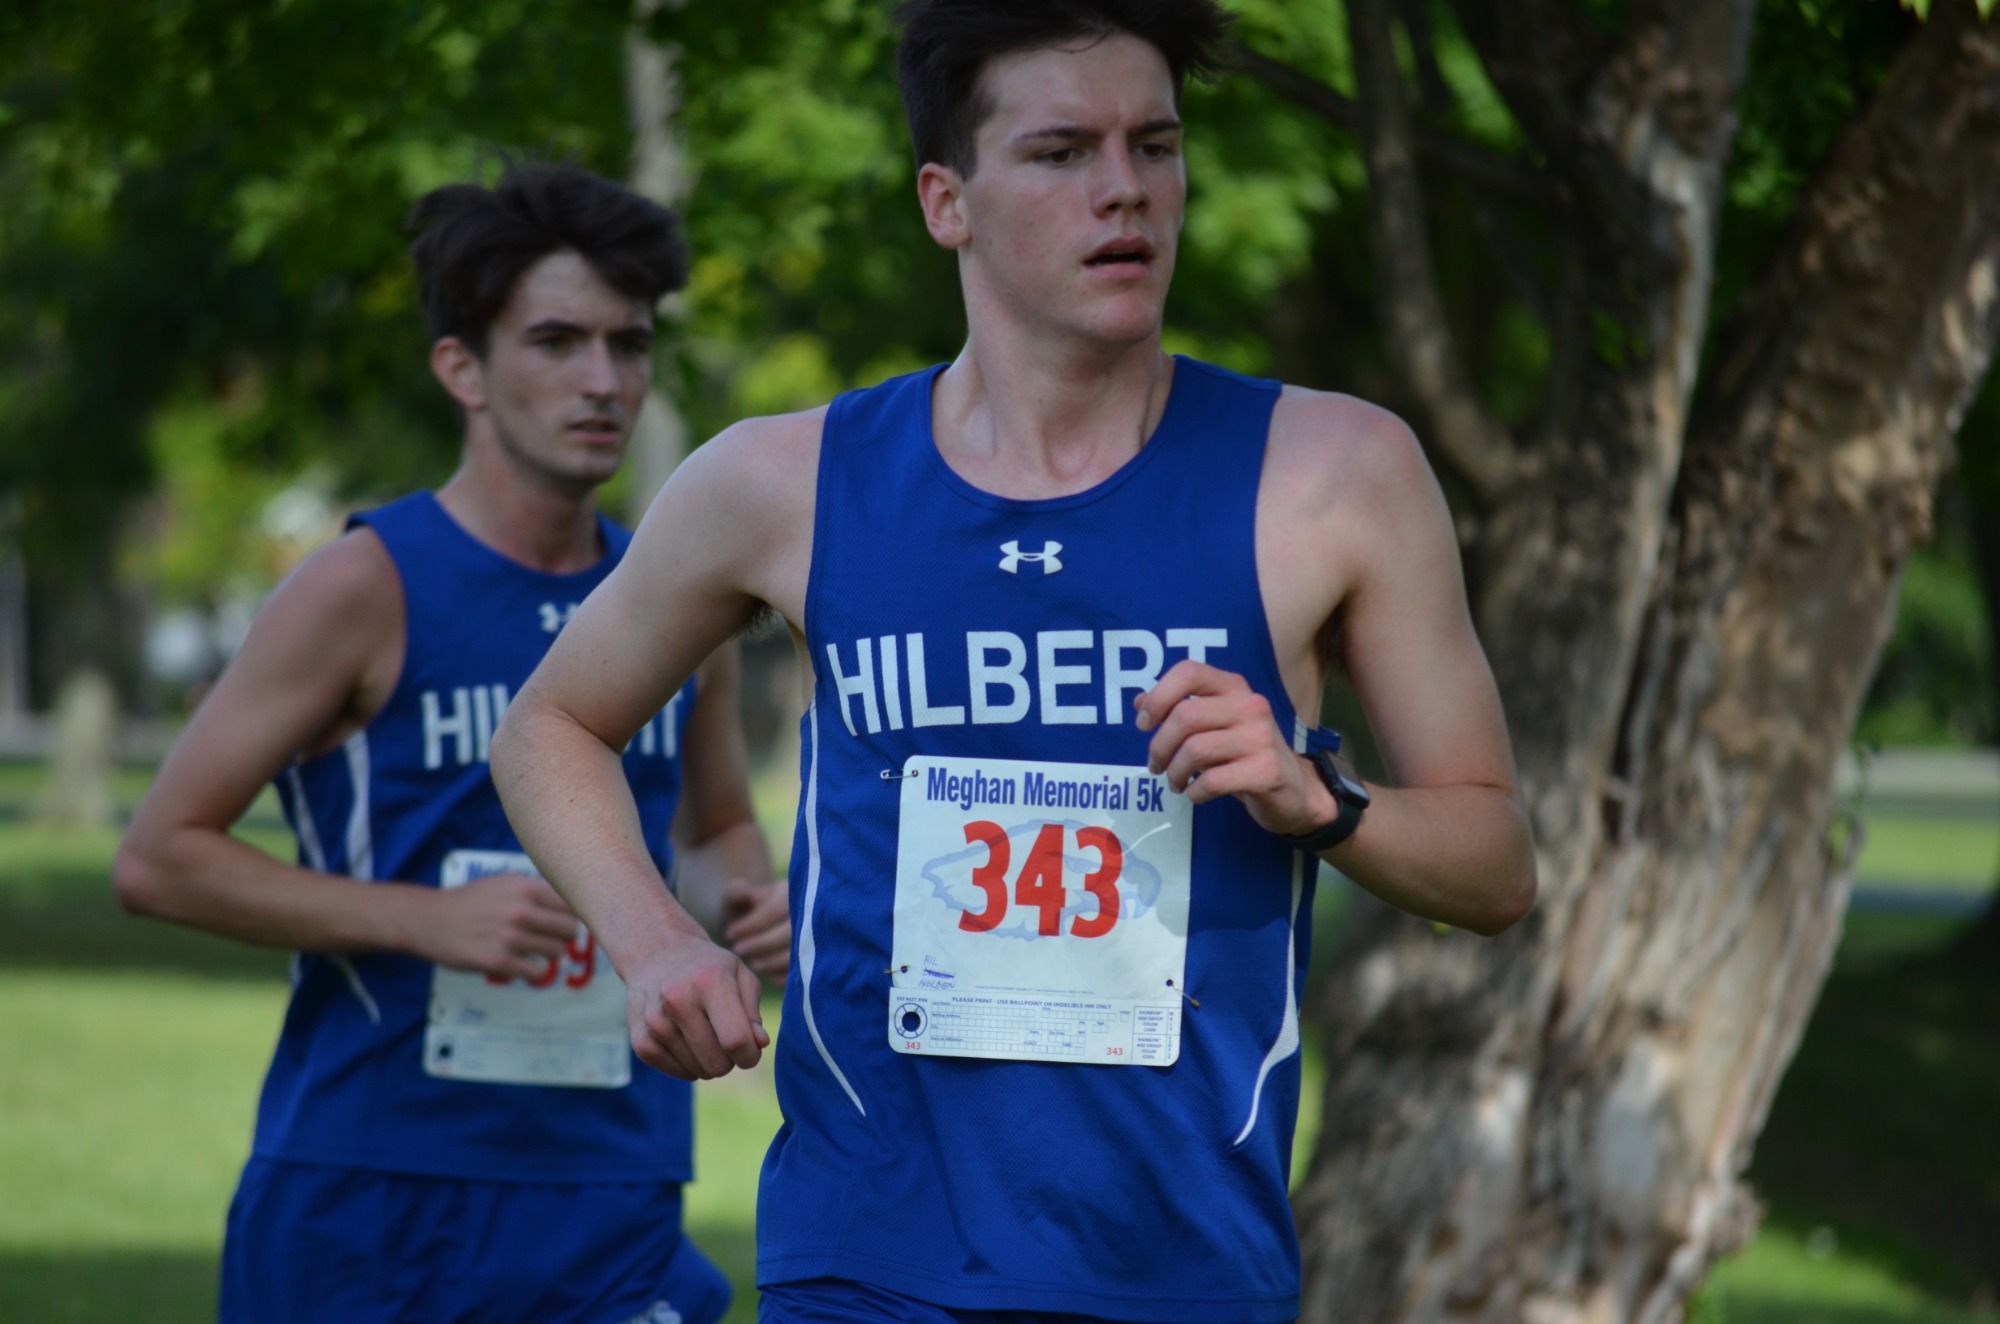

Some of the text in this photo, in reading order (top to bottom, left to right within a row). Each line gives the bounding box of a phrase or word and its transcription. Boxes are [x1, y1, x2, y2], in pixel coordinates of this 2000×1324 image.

[826, 627, 1229, 737] HILBERT
[926, 766, 1165, 813] Meghan Memorial 5k
[957, 820, 1124, 939] 343
[1009, 999, 1043, 1007] BALLPOINT
[905, 1041, 921, 1051] 343
[1106, 1047, 1124, 1056] 343
